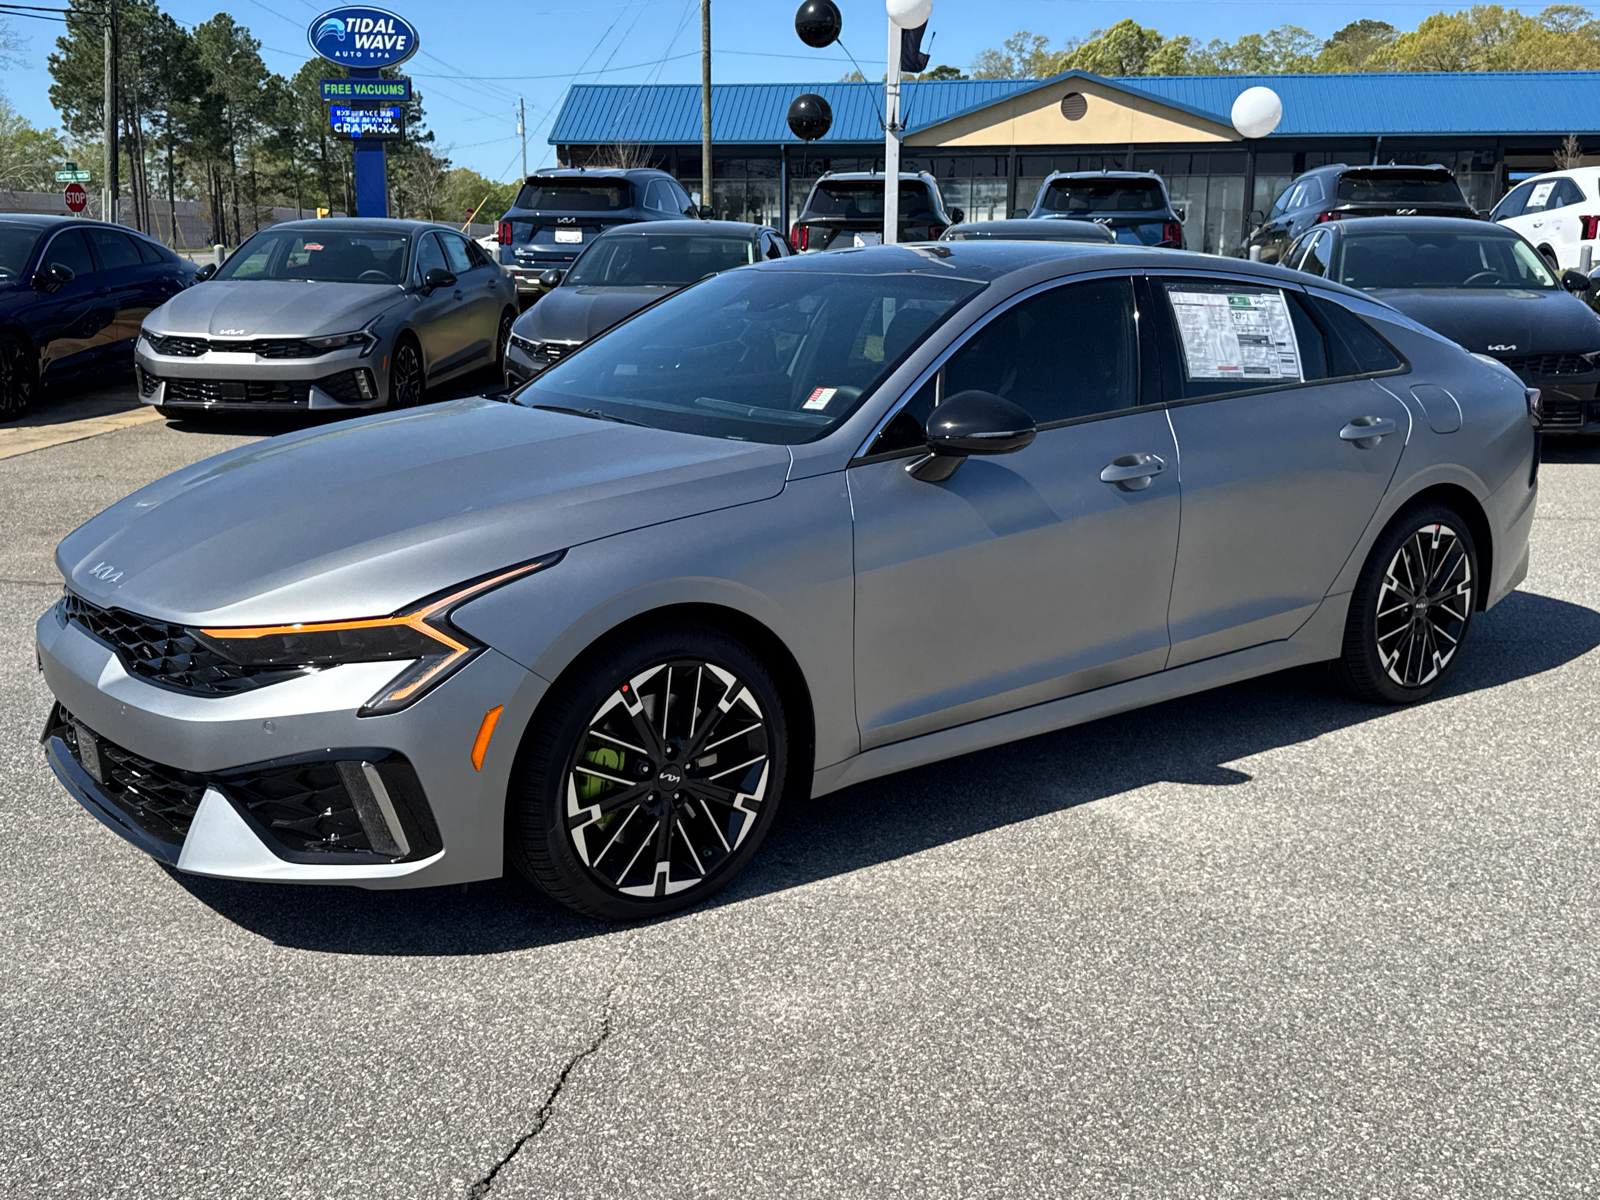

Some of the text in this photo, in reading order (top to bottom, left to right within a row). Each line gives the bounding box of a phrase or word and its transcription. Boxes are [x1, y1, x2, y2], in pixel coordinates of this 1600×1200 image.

[346, 17, 396, 34] TIDAL
[355, 34, 406, 50] WAVE
[324, 83, 405, 95] FREE VACUUMS
[66, 191, 86, 204] STOP
